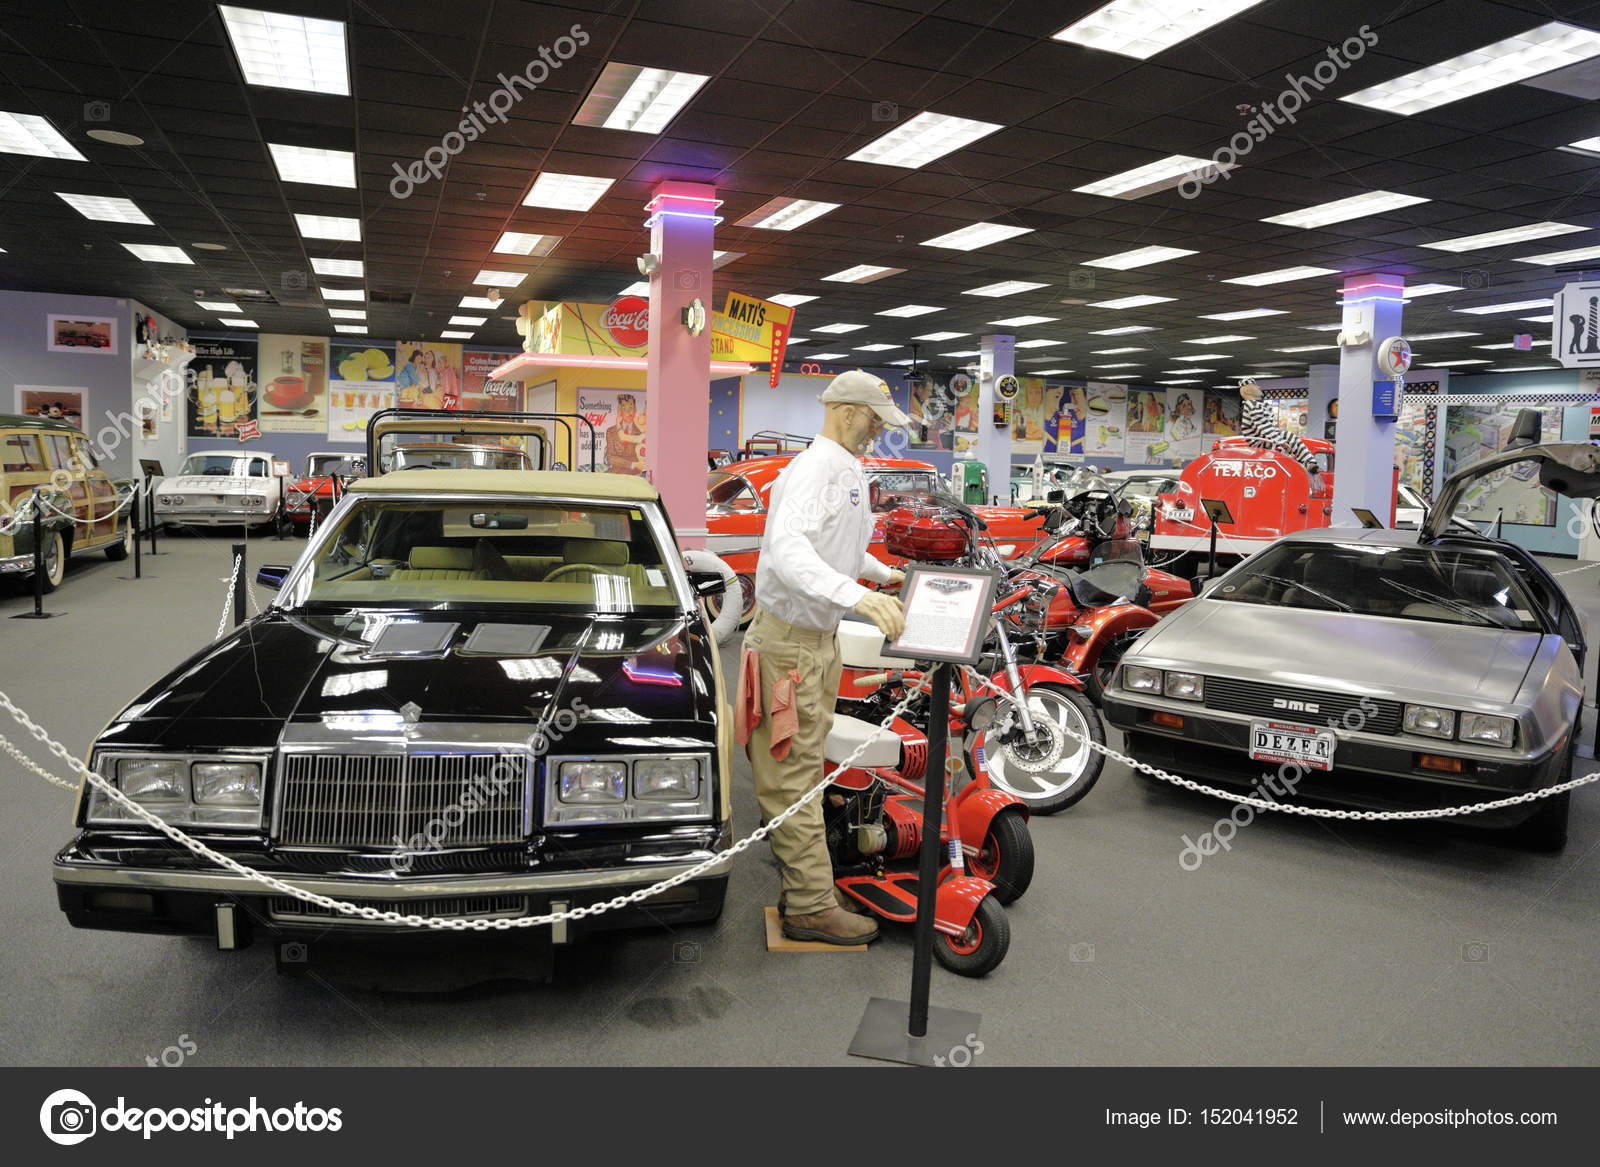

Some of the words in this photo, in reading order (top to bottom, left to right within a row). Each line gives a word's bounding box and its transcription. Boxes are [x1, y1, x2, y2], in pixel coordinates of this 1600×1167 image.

[728, 298, 766, 327] MATI'S
[711, 338, 735, 354] STAND
[580, 396, 612, 413] Something
[581, 411, 608, 427] NEW
[580, 428, 589, 439] has
[591, 429, 605, 439] een
[581, 440, 602, 450] addd!
[1212, 465, 1277, 479] TEXACO
[1257, 732, 1327, 757] DEZER
